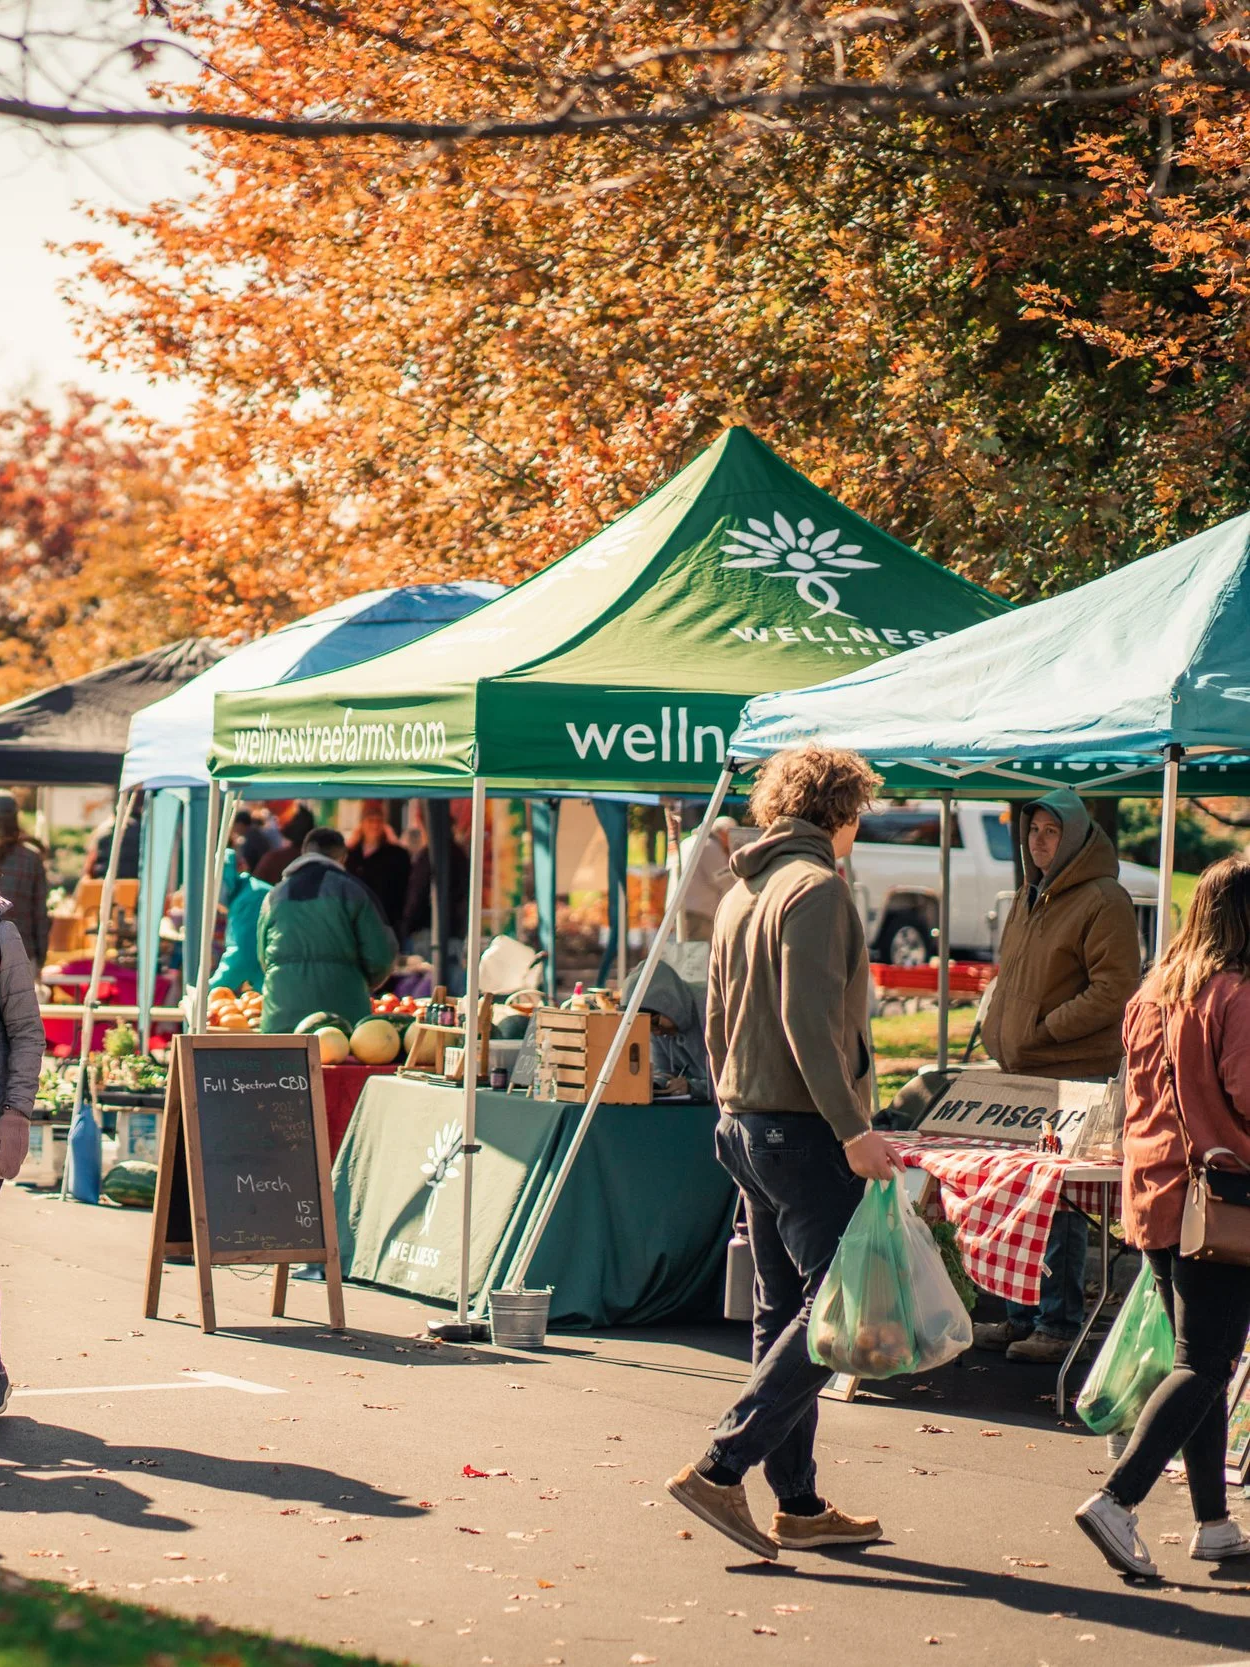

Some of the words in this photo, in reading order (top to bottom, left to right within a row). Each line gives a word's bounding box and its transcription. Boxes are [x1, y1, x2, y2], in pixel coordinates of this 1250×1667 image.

[823, 646, 892, 657] TREE
[234, 708, 446, 764] wellnesstreefarms.com
[203, 1077, 227, 1092] Full
[231, 1078, 277, 1094] Spectrum
[279, 1075, 308, 1090] CBD
[932, 1100, 982, 1122] MT
[236, 1174, 291, 1193] Merch
